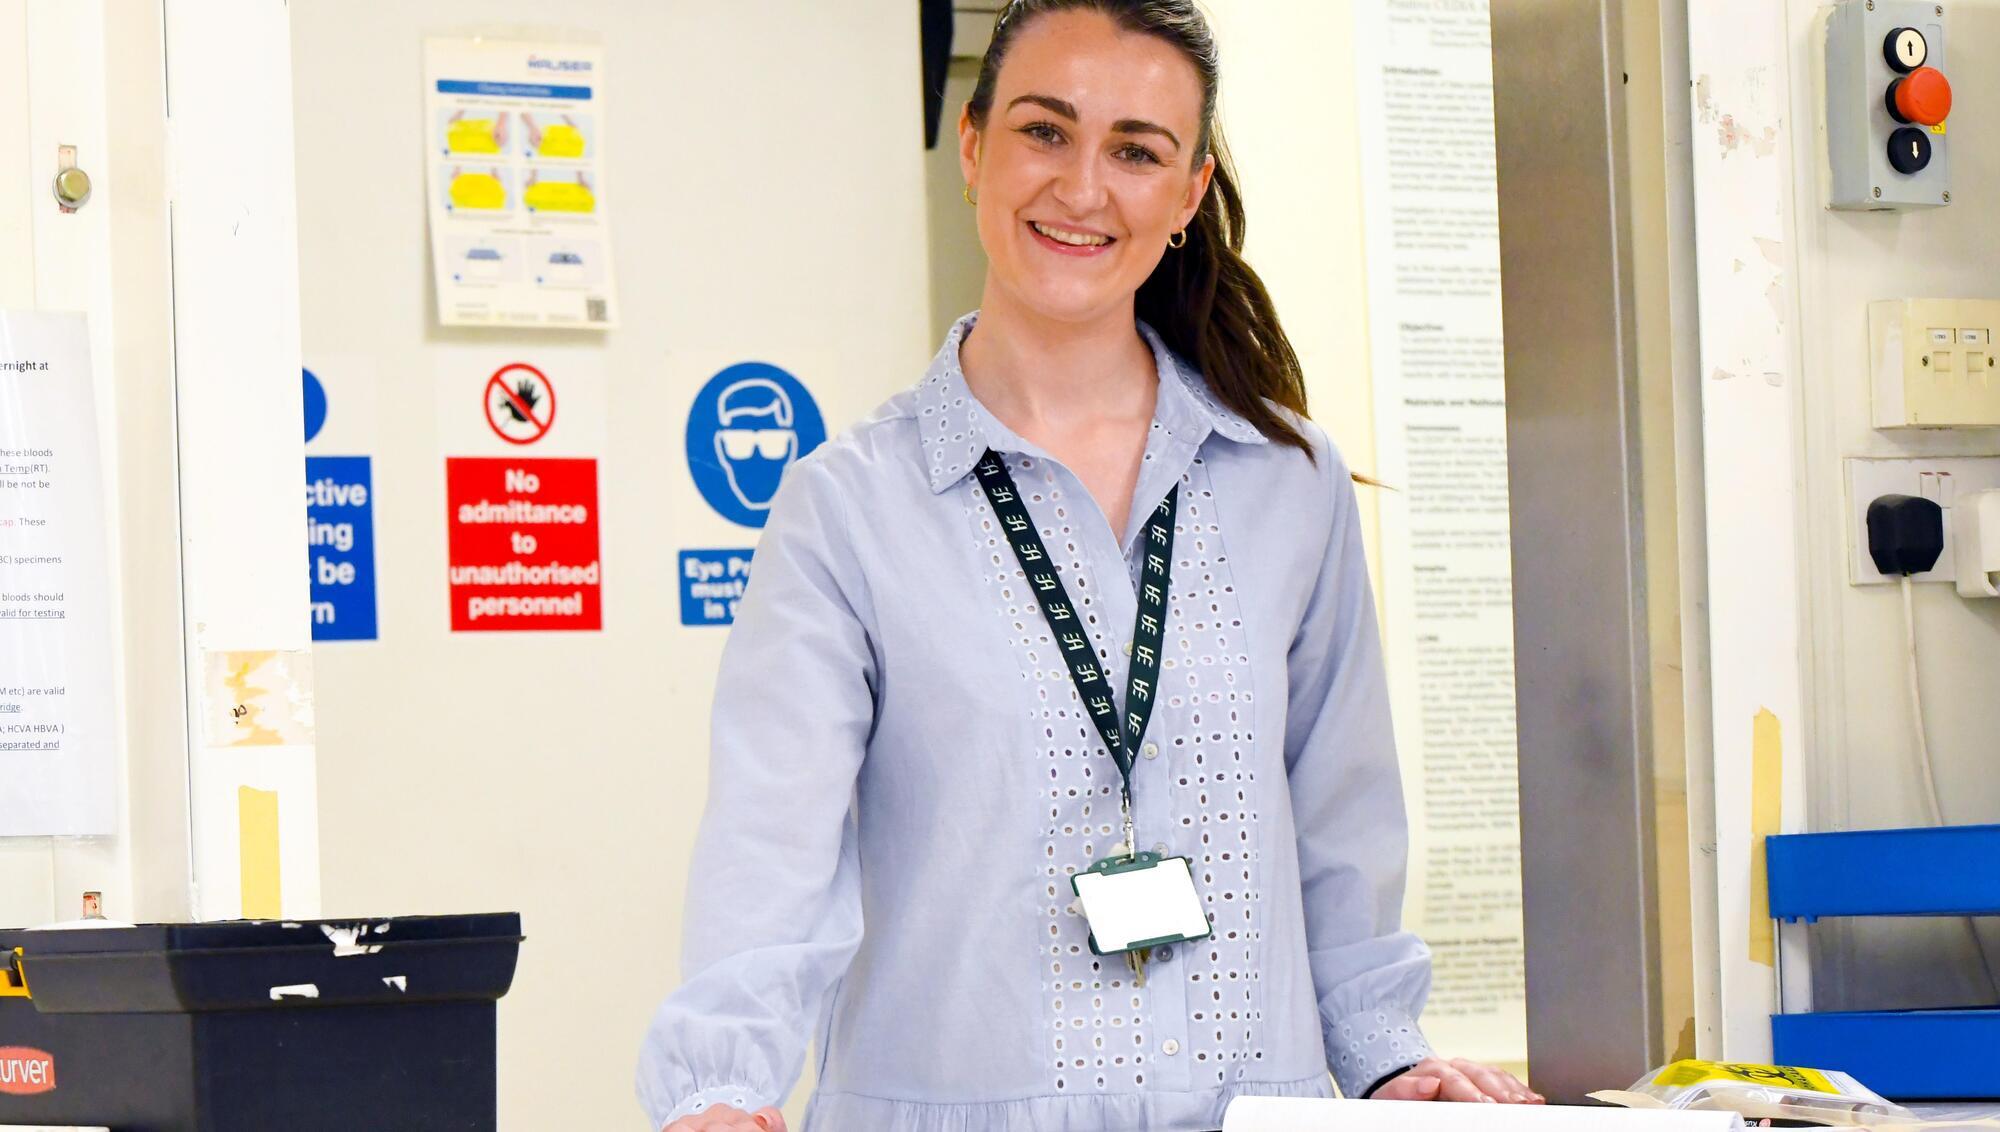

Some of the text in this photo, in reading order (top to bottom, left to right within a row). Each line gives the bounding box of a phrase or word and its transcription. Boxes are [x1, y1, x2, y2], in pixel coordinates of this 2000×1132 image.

[40, 362, 49, 371] at
[24, 448, 53, 457] bloods
[7, 480, 18, 488] be
[39, 480, 50, 488] be
[505, 468, 540, 494] No
[458, 499, 588, 524] admittance
[19, 517, 46, 526] These
[511, 531, 537, 555] to
[15, 556, 62, 565] specimens
[317, 556, 355, 585] be
[450, 560, 599, 586] unauthorised
[685, 557, 724, 581] Eye
[691, 580, 742, 599] must
[2, 593, 64, 601] bloods should
[468, 591, 582, 621] personnel
[703, 599, 725, 619] in
[19, 609, 32, 617] for
[35, 609, 65, 619] testing
[9, 687, 25, 696] etc)
[27, 688, 41, 696] are
[43, 687, 65, 695] valid
[8, 725, 31, 733] HCVA
[34, 725, 59, 733] HBVA
[43, 740, 60, 748] and
[0, 1059, 49, 1085] urver
